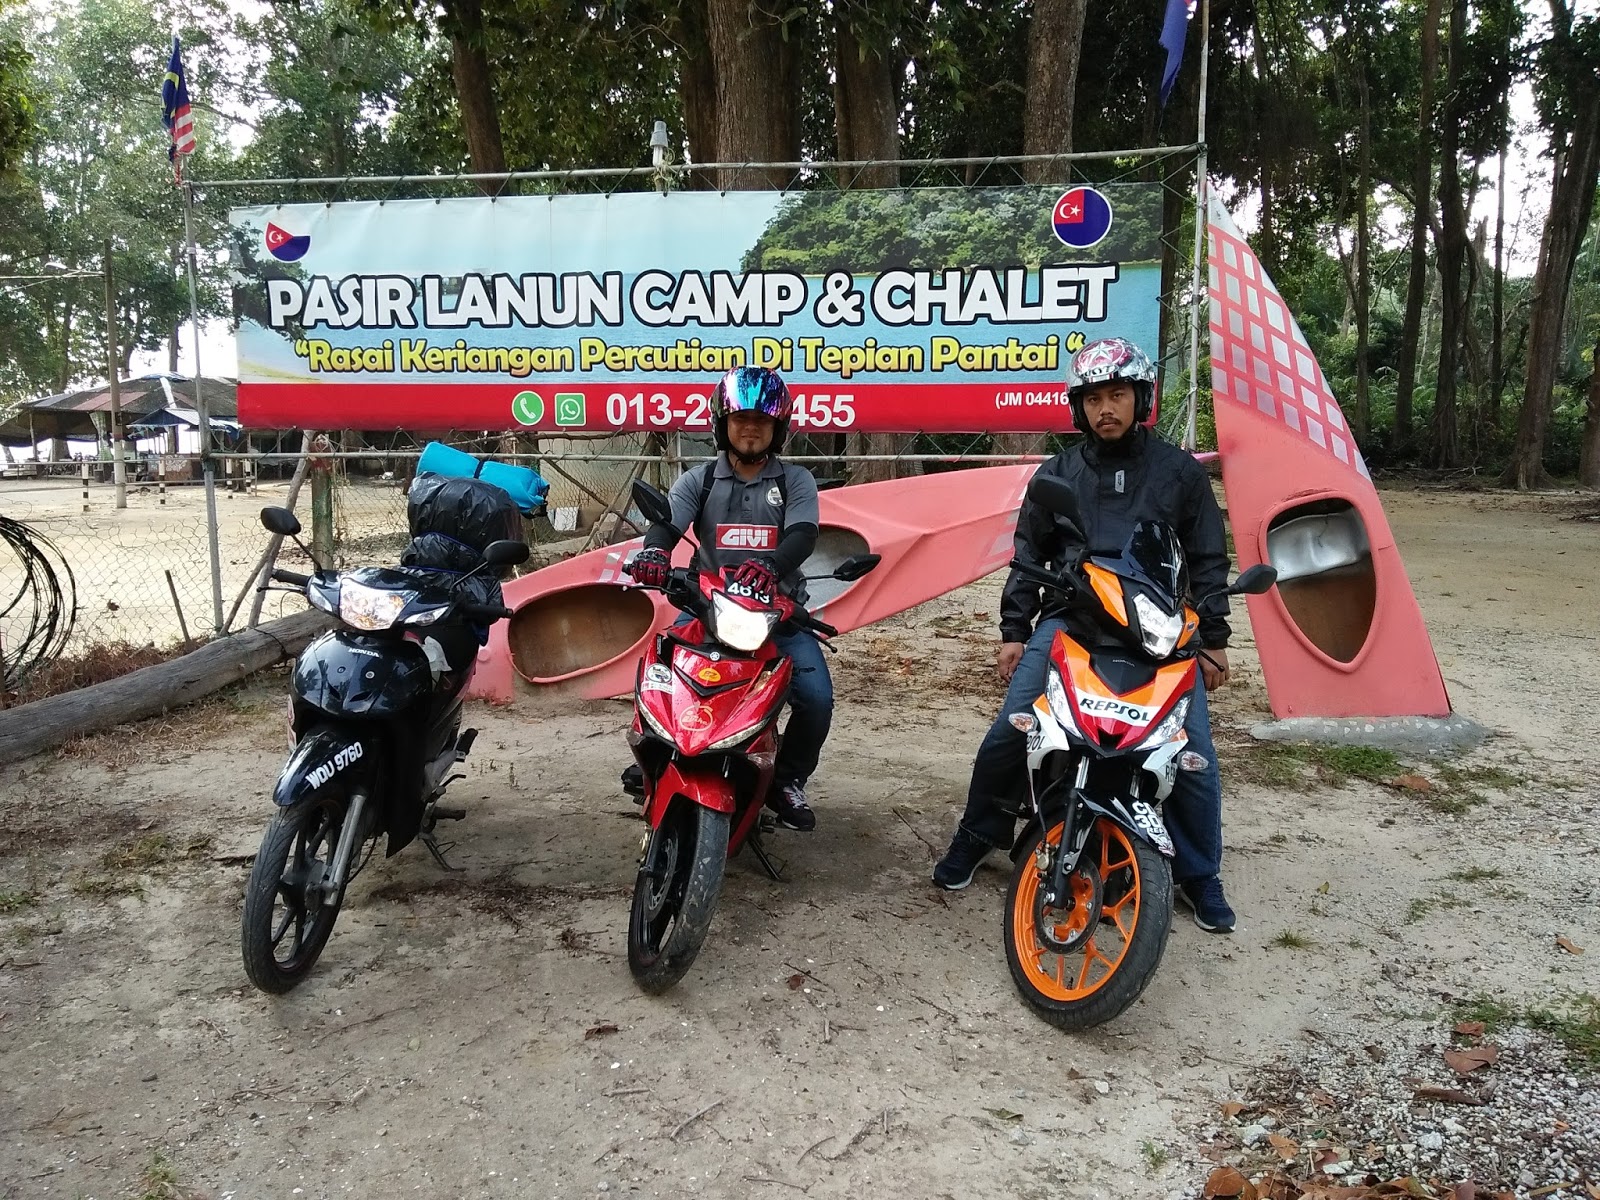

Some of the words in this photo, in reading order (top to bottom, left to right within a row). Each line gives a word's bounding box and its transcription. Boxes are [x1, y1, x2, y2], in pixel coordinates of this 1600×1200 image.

[266, 273, 418, 329] PASIR
[421, 271, 624, 329] LANUN
[631, 268, 808, 328] CAMP
[813, 267, 865, 327] &
[870, 263, 1120, 327] CHALET
[399, 338, 576, 377] Keriangan
[579, 337, 746, 374] Percutian
[753, 336, 793, 372] Di
[798, 336, 928, 378] Tepian
[930, 333, 1059, 371] Pantai
[606, 392, 857, 427] 013-2455
[995, 391, 1022, 409] (JM
[721, 528, 769, 548] GIVI
[348, 647, 380, 658] HONDA
[1080, 698, 1150, 722] REPSOL
[334, 741, 363, 771] 9760
